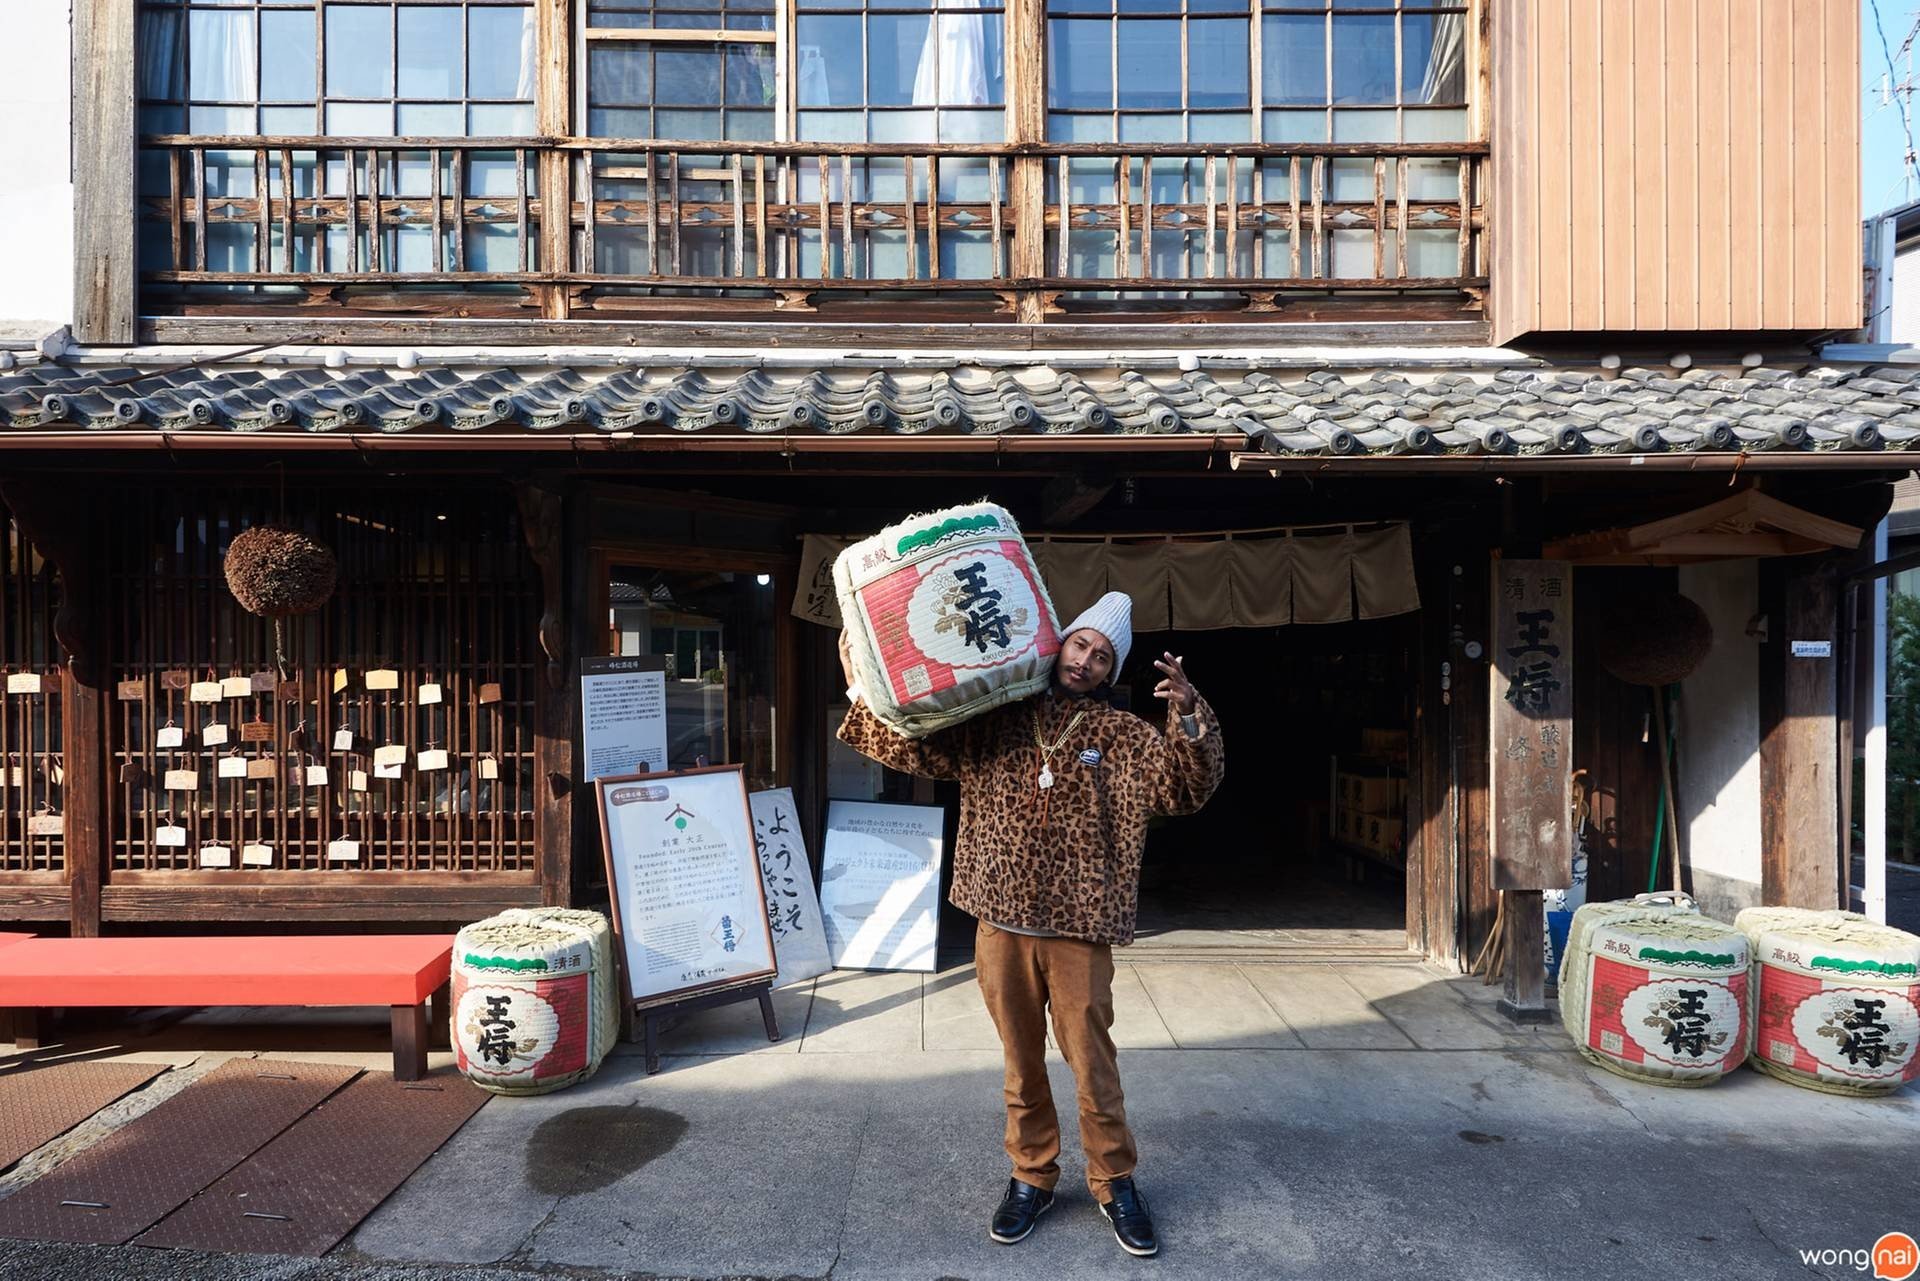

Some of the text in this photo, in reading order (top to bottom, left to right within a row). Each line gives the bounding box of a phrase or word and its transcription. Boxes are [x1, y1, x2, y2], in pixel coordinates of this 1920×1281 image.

[954, 561, 1011, 653] 王将
[1504, 576, 1562, 600] 清酒
[1504, 609, 1561, 712] 王将
[769, 806, 803, 930] ようこそ
[553, 954, 582, 970] 清酒
[1604, 939, 1633, 957] 高級
[1772, 947, 1801, 964] 高級
[477, 995, 516, 1065] 王将
[1663, 989, 1712, 1057] 王将
[1838, 998, 1890, 1068] 王将
